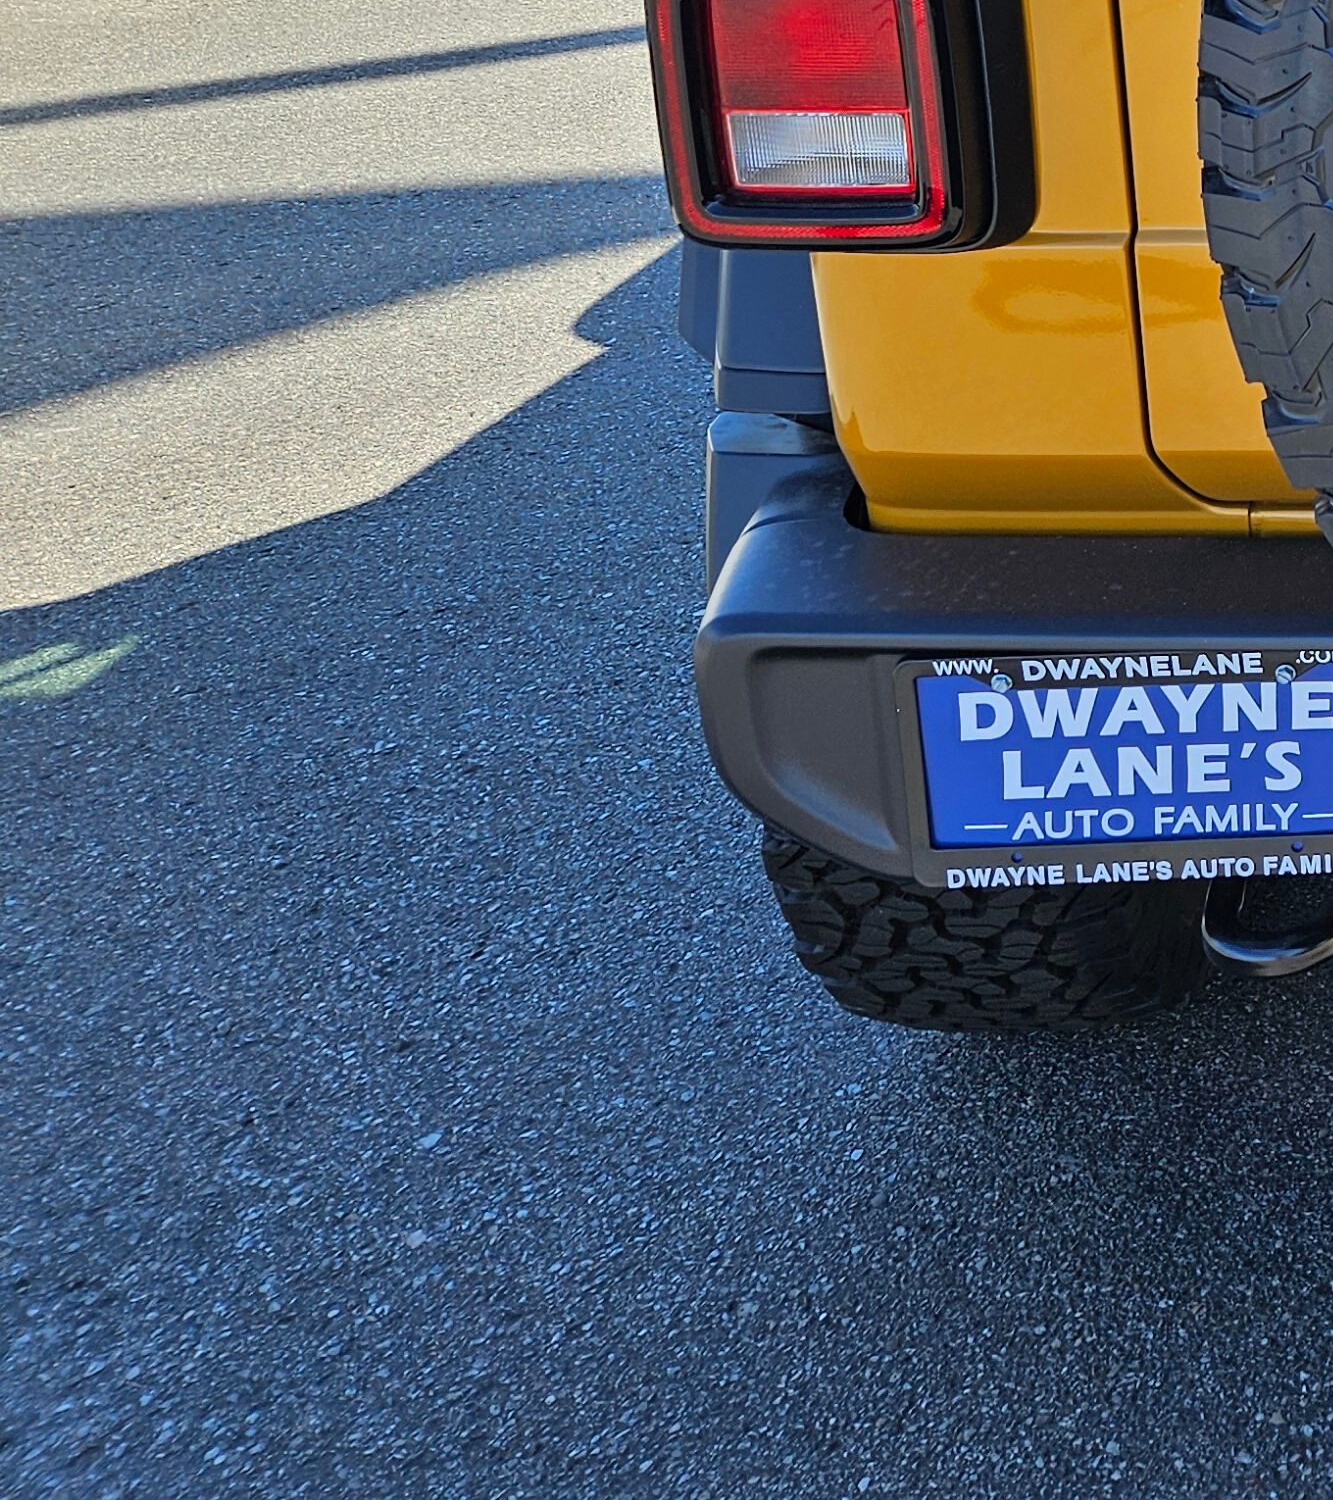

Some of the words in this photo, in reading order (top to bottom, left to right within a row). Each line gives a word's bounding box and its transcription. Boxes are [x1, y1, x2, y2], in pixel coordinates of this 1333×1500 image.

[1021, 652, 1264, 682] DWAYNELANE
[1002, 741, 1303, 801] LANE'S
[1012, 807, 1135, 841] AUTO
[1153, 802, 1300, 835] FAMILY
[946, 865, 1065, 890] DWAYNE
[1076, 861, 1172, 885] LANE'S
[1181, 858, 1256, 881] AUTO
